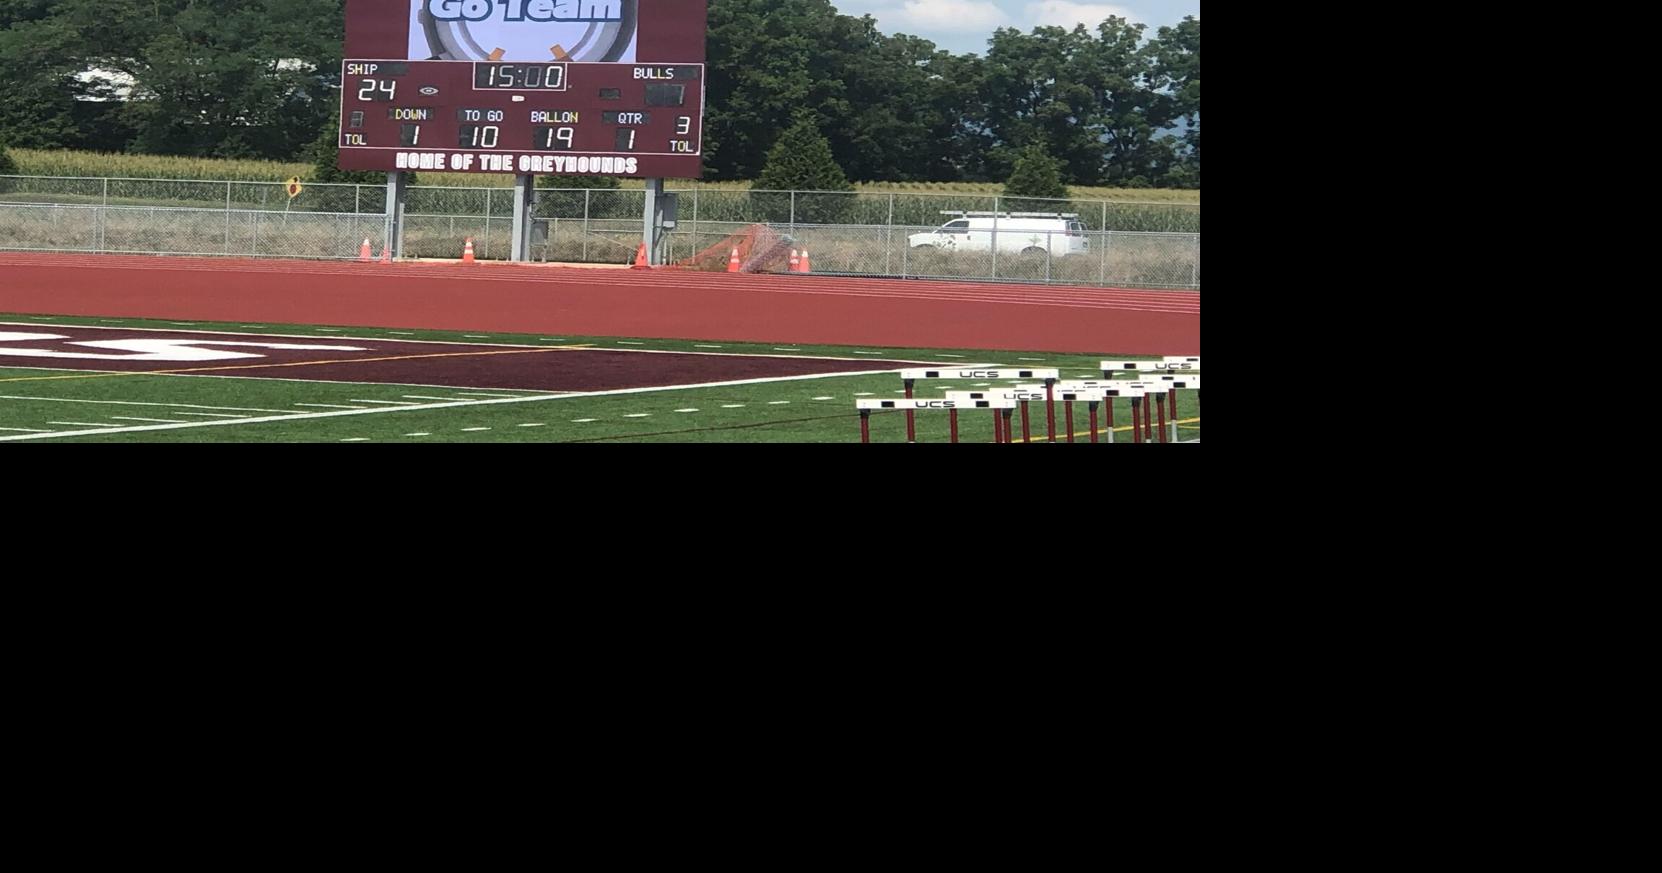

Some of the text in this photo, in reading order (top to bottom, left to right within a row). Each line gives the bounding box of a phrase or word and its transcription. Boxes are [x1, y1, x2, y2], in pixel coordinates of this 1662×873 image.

[428, 0, 622, 20] Go Team
[347, 64, 378, 75] SHIP
[633, 67, 674, 79] BULLS
[489, 65, 563, 88] 15:00
[358, 79, 396, 101] 24
[395, 108, 427, 121] DOWN
[465, 109, 504, 122] TO GO
[530, 111, 579, 123] BALLON
[618, 112, 643, 124] QTR
[676, 116, 691, 134] 3
[344, 134, 367, 146] TOL
[412, 125, 420, 145] 1
[472, 125, 499, 148] 10
[546, 127, 574, 148] 19
[628, 129, 636, 150] 1
[669, 140, 694, 152] TOL
[396, 152, 638, 174] HOME OF THE GREYHOUNDS
[1155, 362, 1192, 370] UCS
[959, 370, 1000, 378] UCS
[915, 400, 956, 408] UCS
